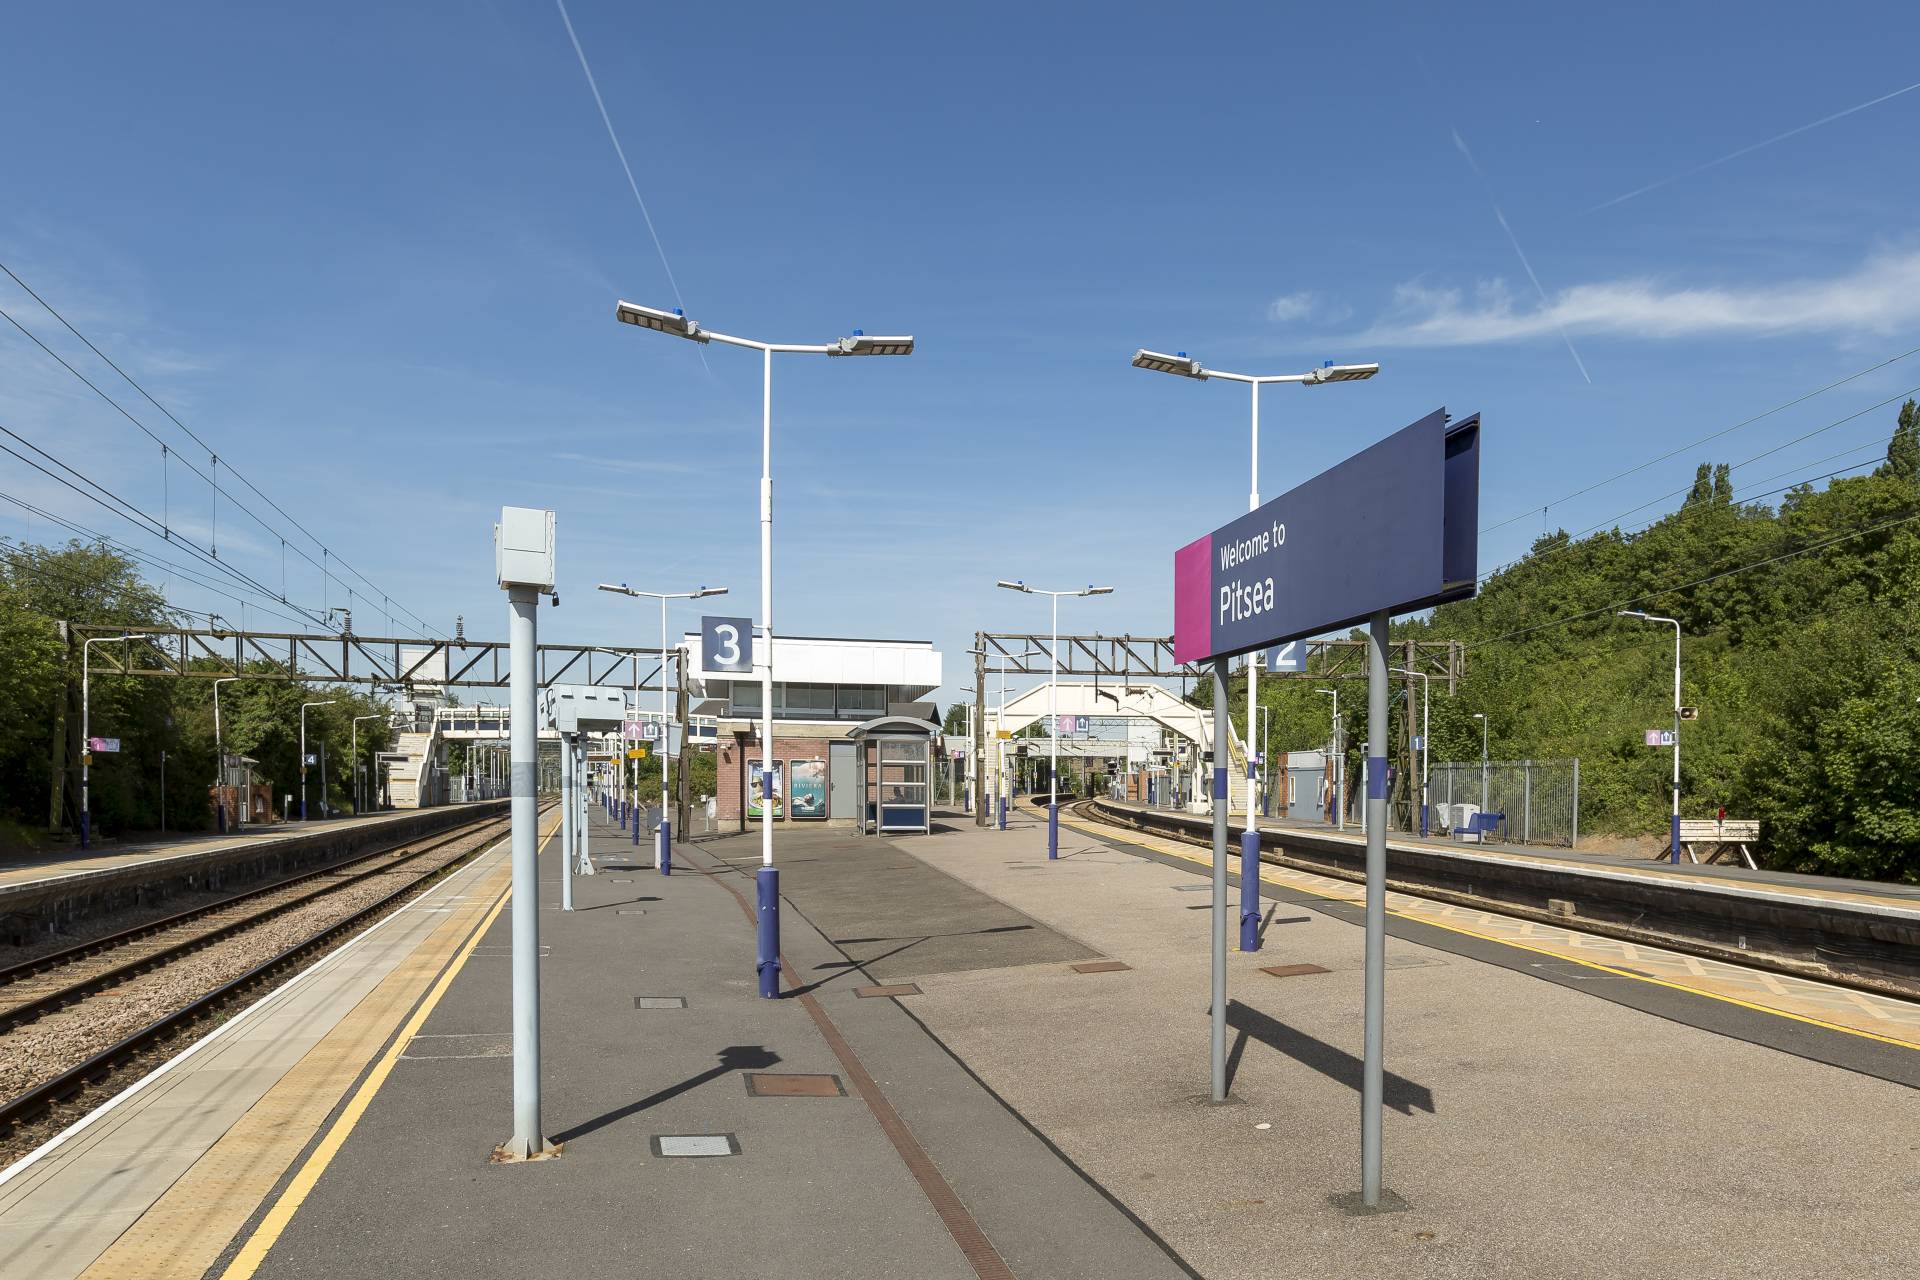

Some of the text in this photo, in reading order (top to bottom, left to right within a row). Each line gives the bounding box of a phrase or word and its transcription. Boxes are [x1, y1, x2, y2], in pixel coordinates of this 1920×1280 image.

[1220, 519, 1286, 572] Welcome to
[1220, 577, 1274, 626] Pitsea
[713, 623, 741, 665] 3
[1275, 640, 1297, 666] 2
[307, 755, 315, 764] 4
[1414, 737, 1419, 750] 1
